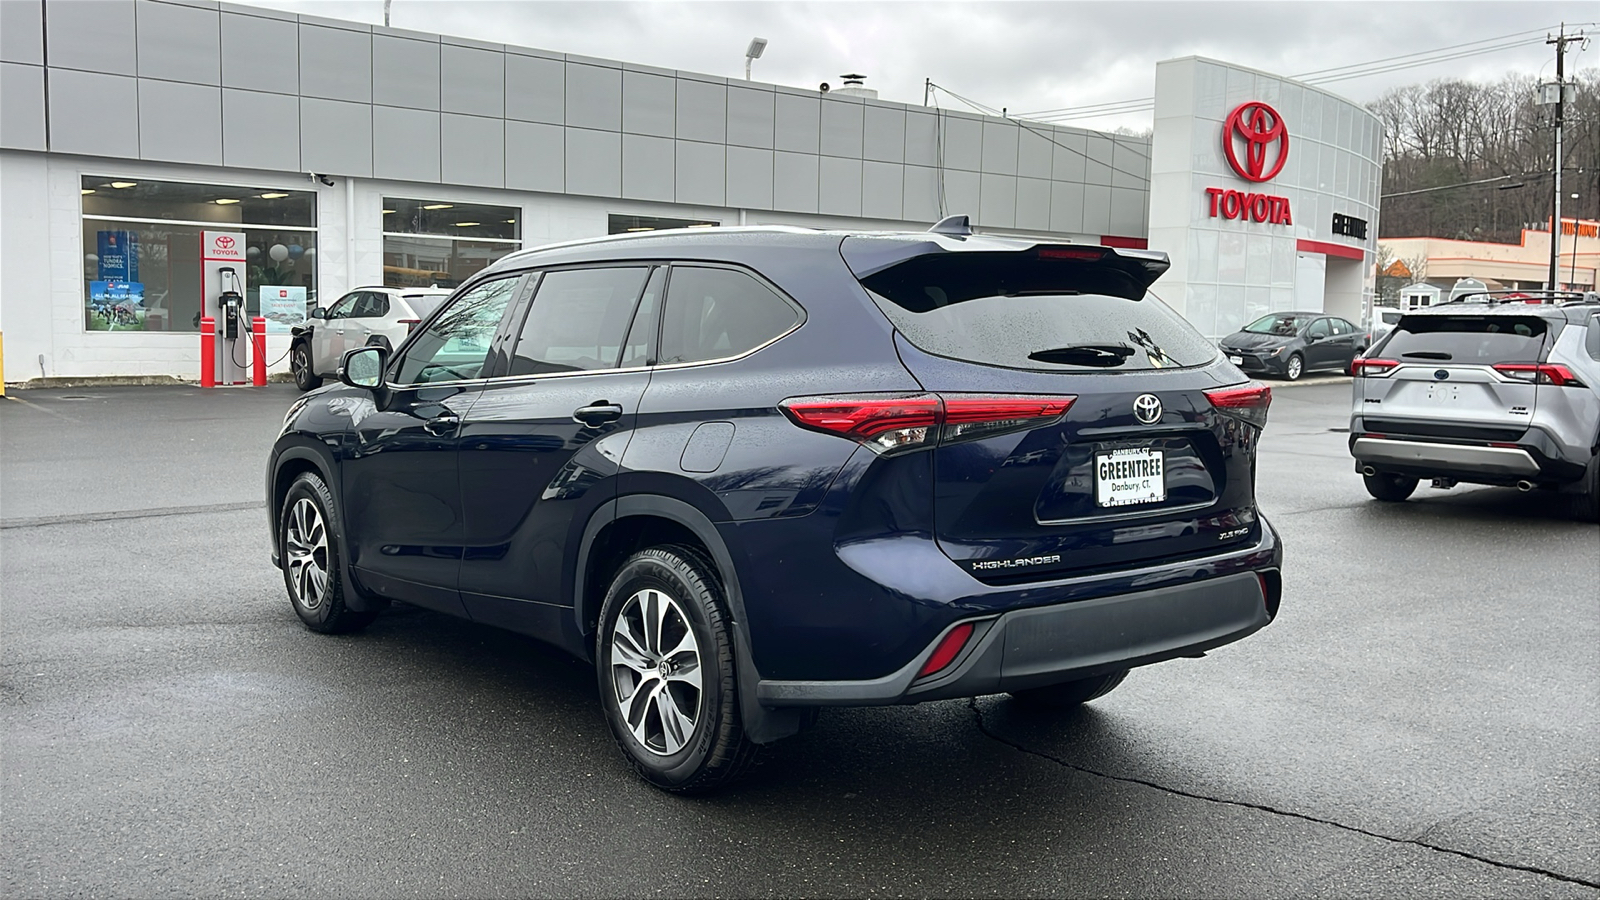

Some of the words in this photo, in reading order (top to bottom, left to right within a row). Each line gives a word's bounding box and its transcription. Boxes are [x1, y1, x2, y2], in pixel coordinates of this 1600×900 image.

[1206, 187, 1292, 225] TOYOTA
[1100, 459, 1160, 481] GREENTREE
[1111, 481, 1141, 493] Danbury,
[1141, 480, 1151, 489] CT.
[972, 555, 1061, 570] HIGHLANDER
